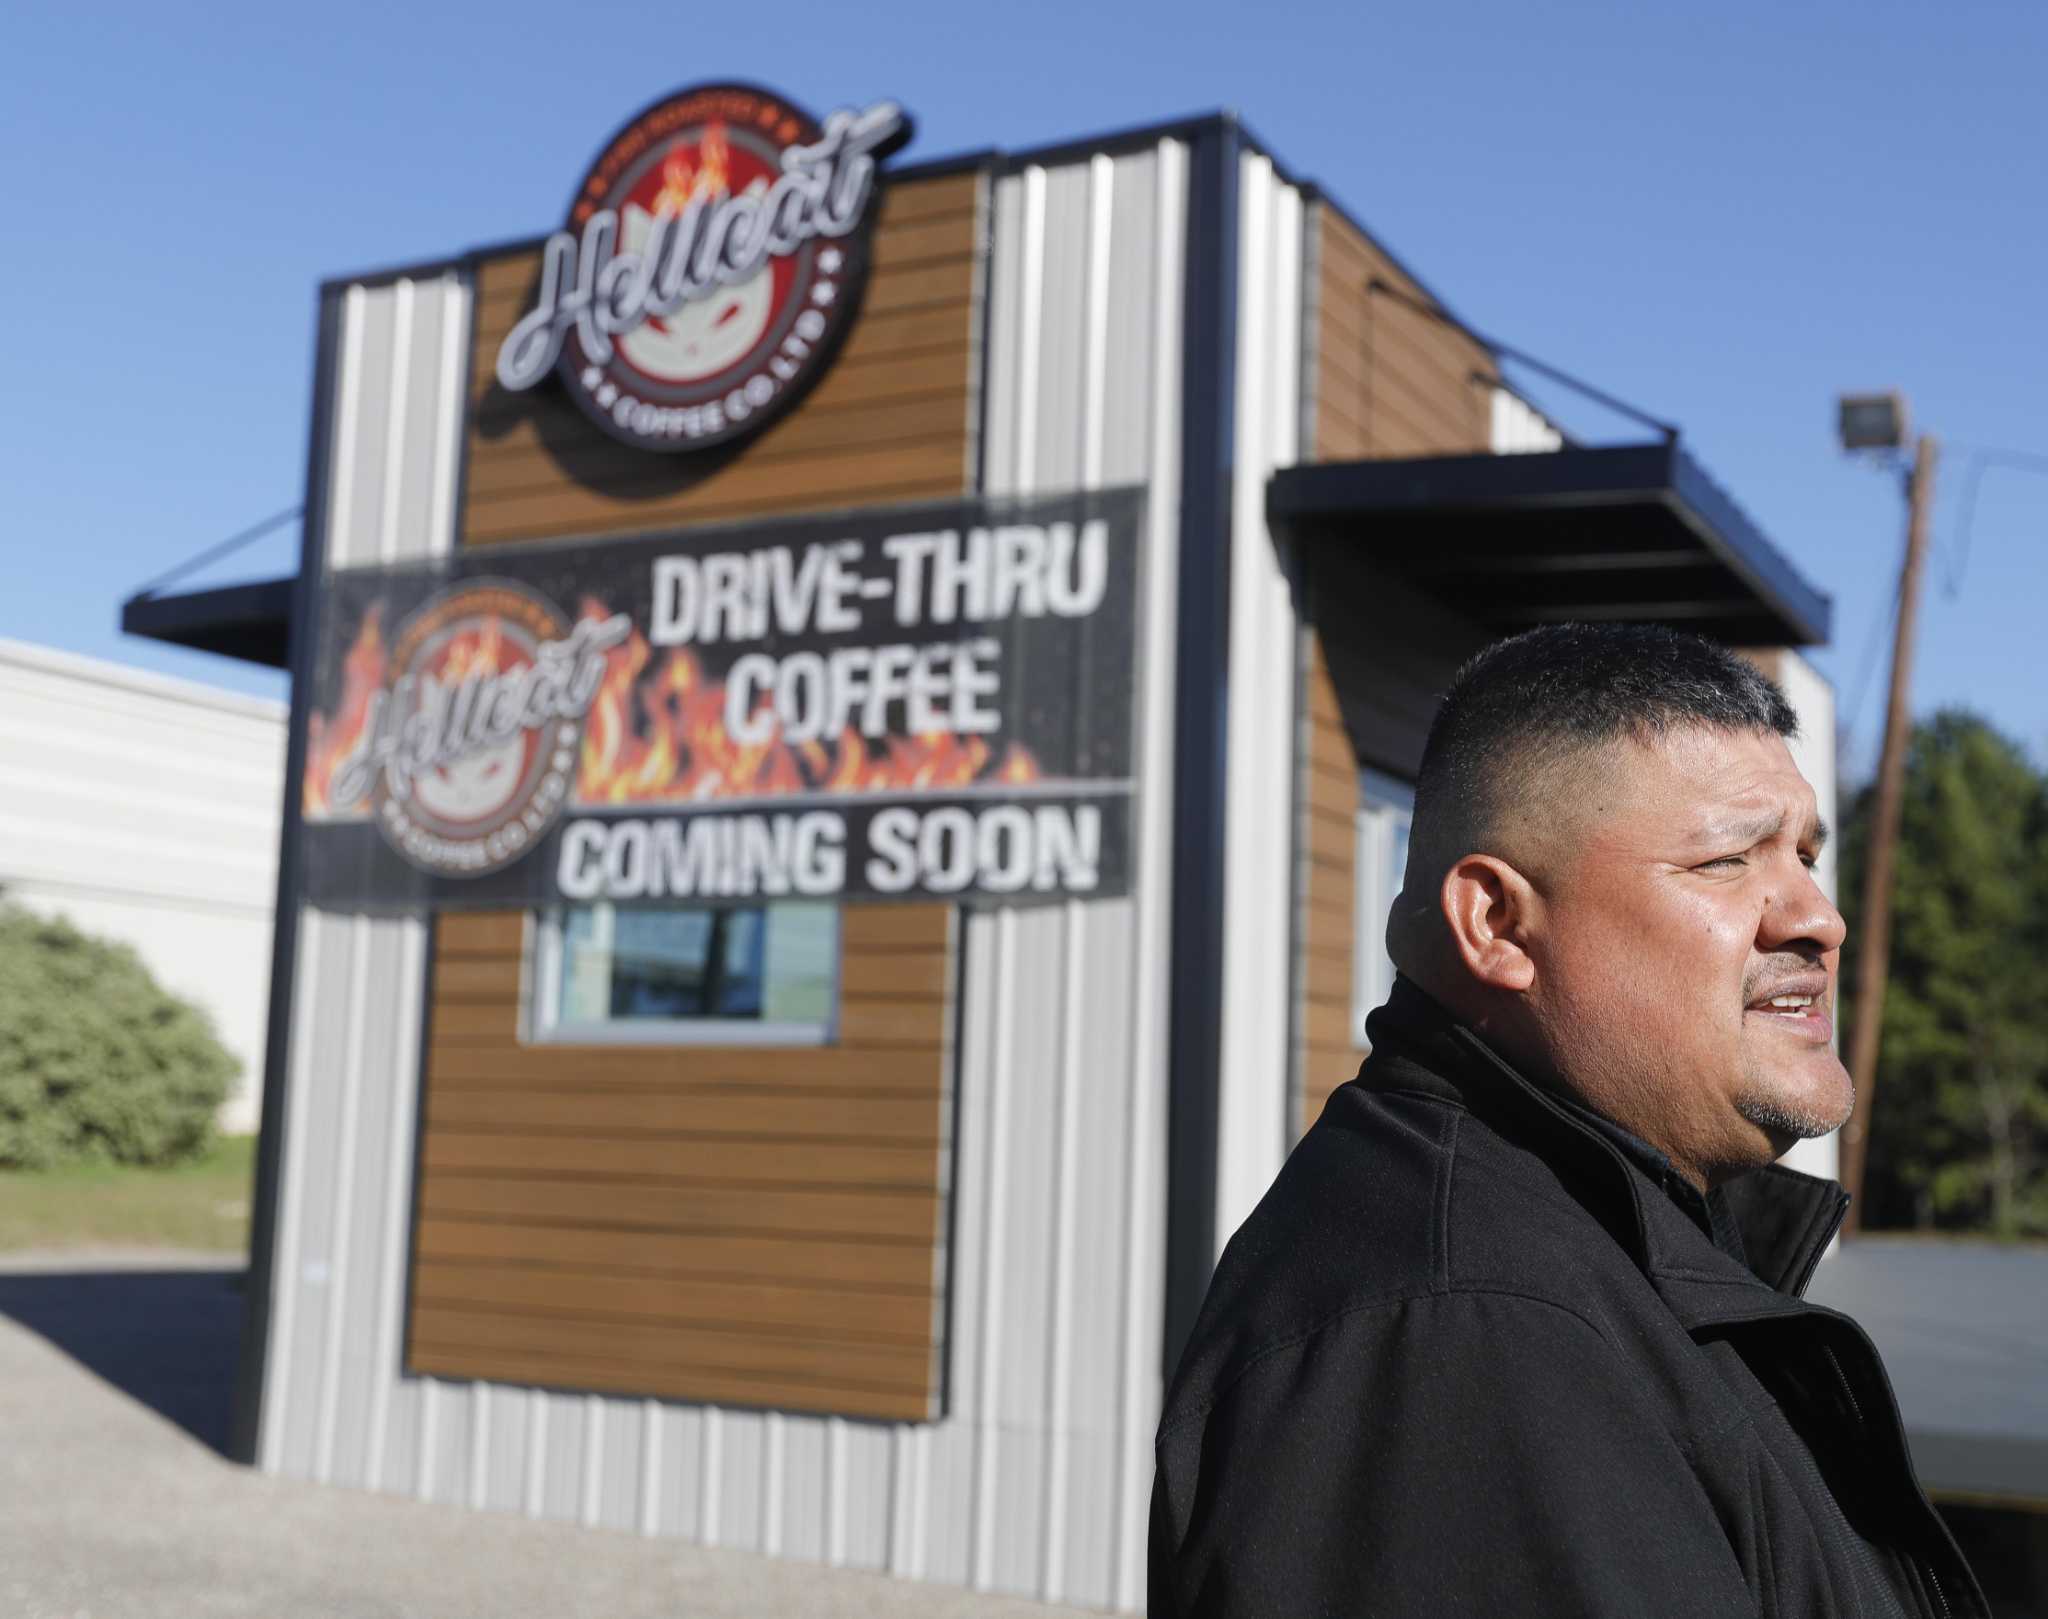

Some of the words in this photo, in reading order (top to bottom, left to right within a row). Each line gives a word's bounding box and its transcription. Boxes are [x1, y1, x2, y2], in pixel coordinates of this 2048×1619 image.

[496, 101, 902, 392] Hellcat
[612, 394, 726, 438] COFFEE
[649, 519, 1109, 646] DRIVE-THRU
[329, 611, 632, 805] Hellcat
[724, 636, 1001, 746] COFFEE
[556, 811, 847, 900] COMING
[864, 804, 1101, 893] SOON
